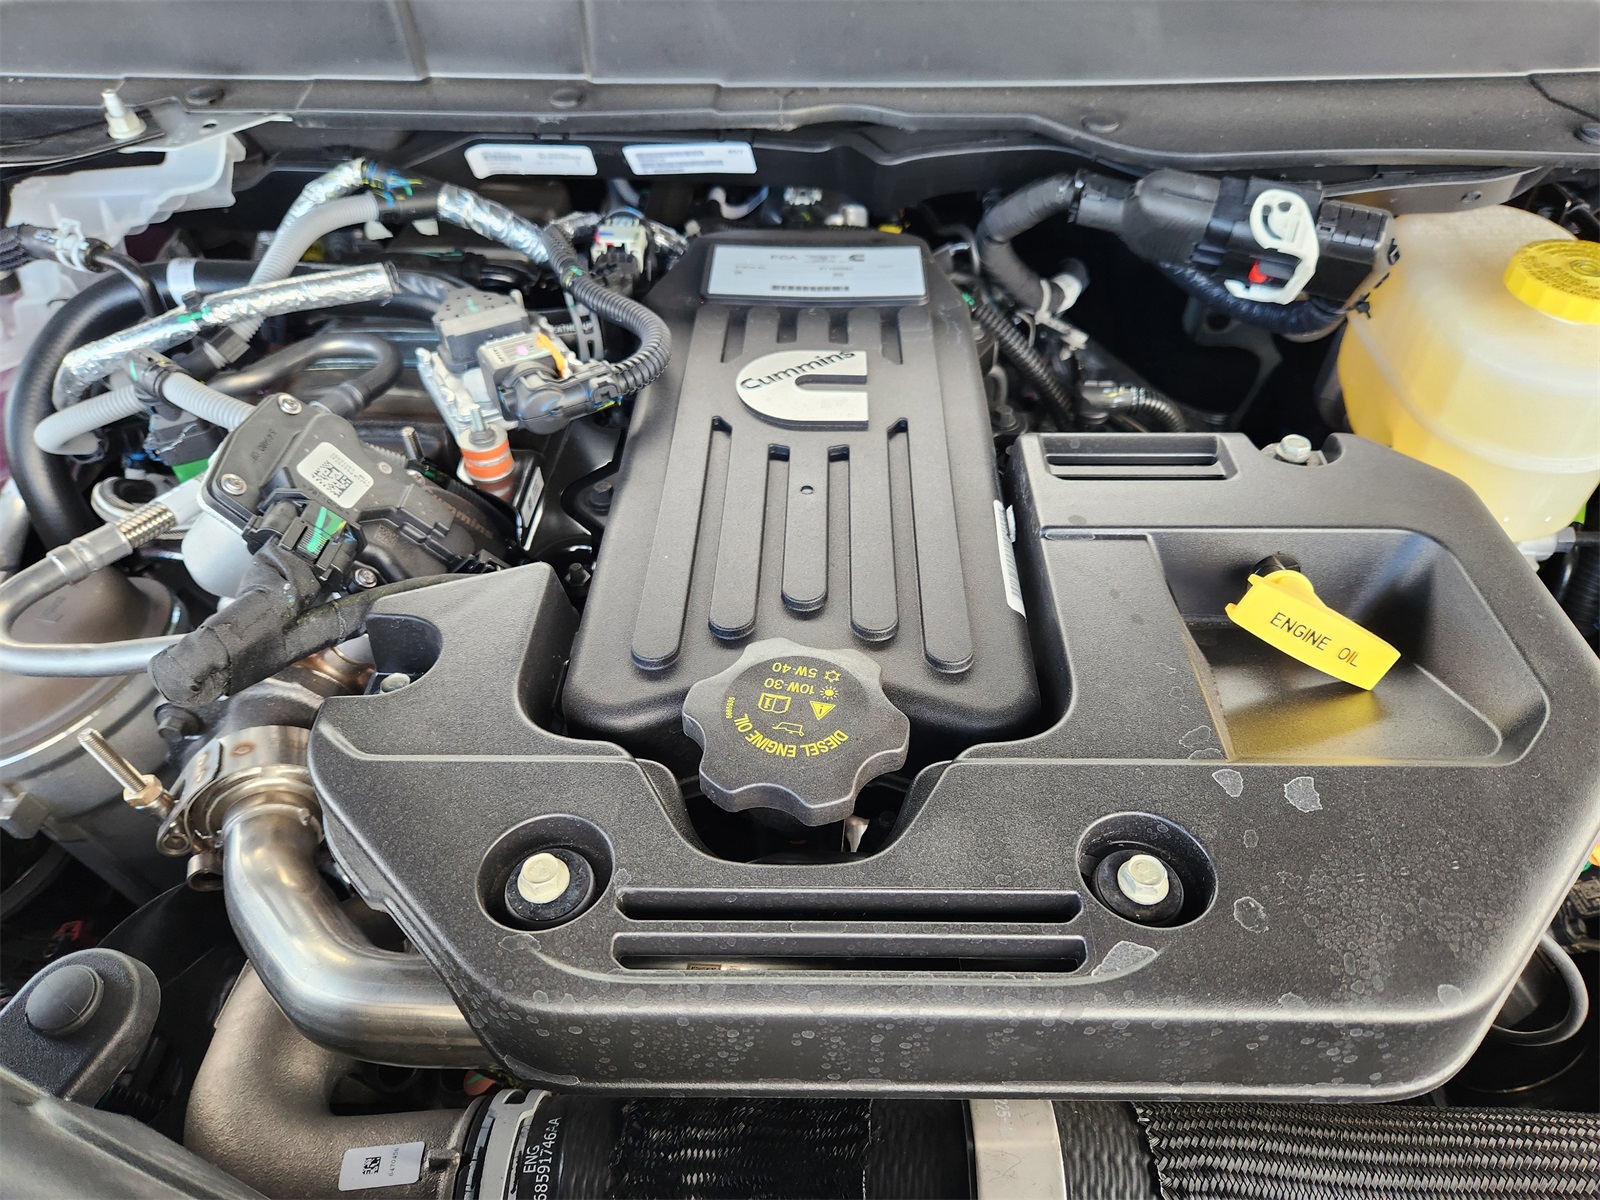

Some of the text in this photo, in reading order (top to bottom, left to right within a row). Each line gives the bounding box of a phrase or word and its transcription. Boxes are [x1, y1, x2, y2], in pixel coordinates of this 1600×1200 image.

[740, 351, 855, 390] Cummins
[1270, 612, 1360, 668] ENGINE OIL
[763, 677, 815, 695] 10W-30
[772, 662, 818, 678] 5W-40
[734, 713, 849, 757] DIESEL ENGINE OIL
[523, 1144, 540, 1174] ENG
